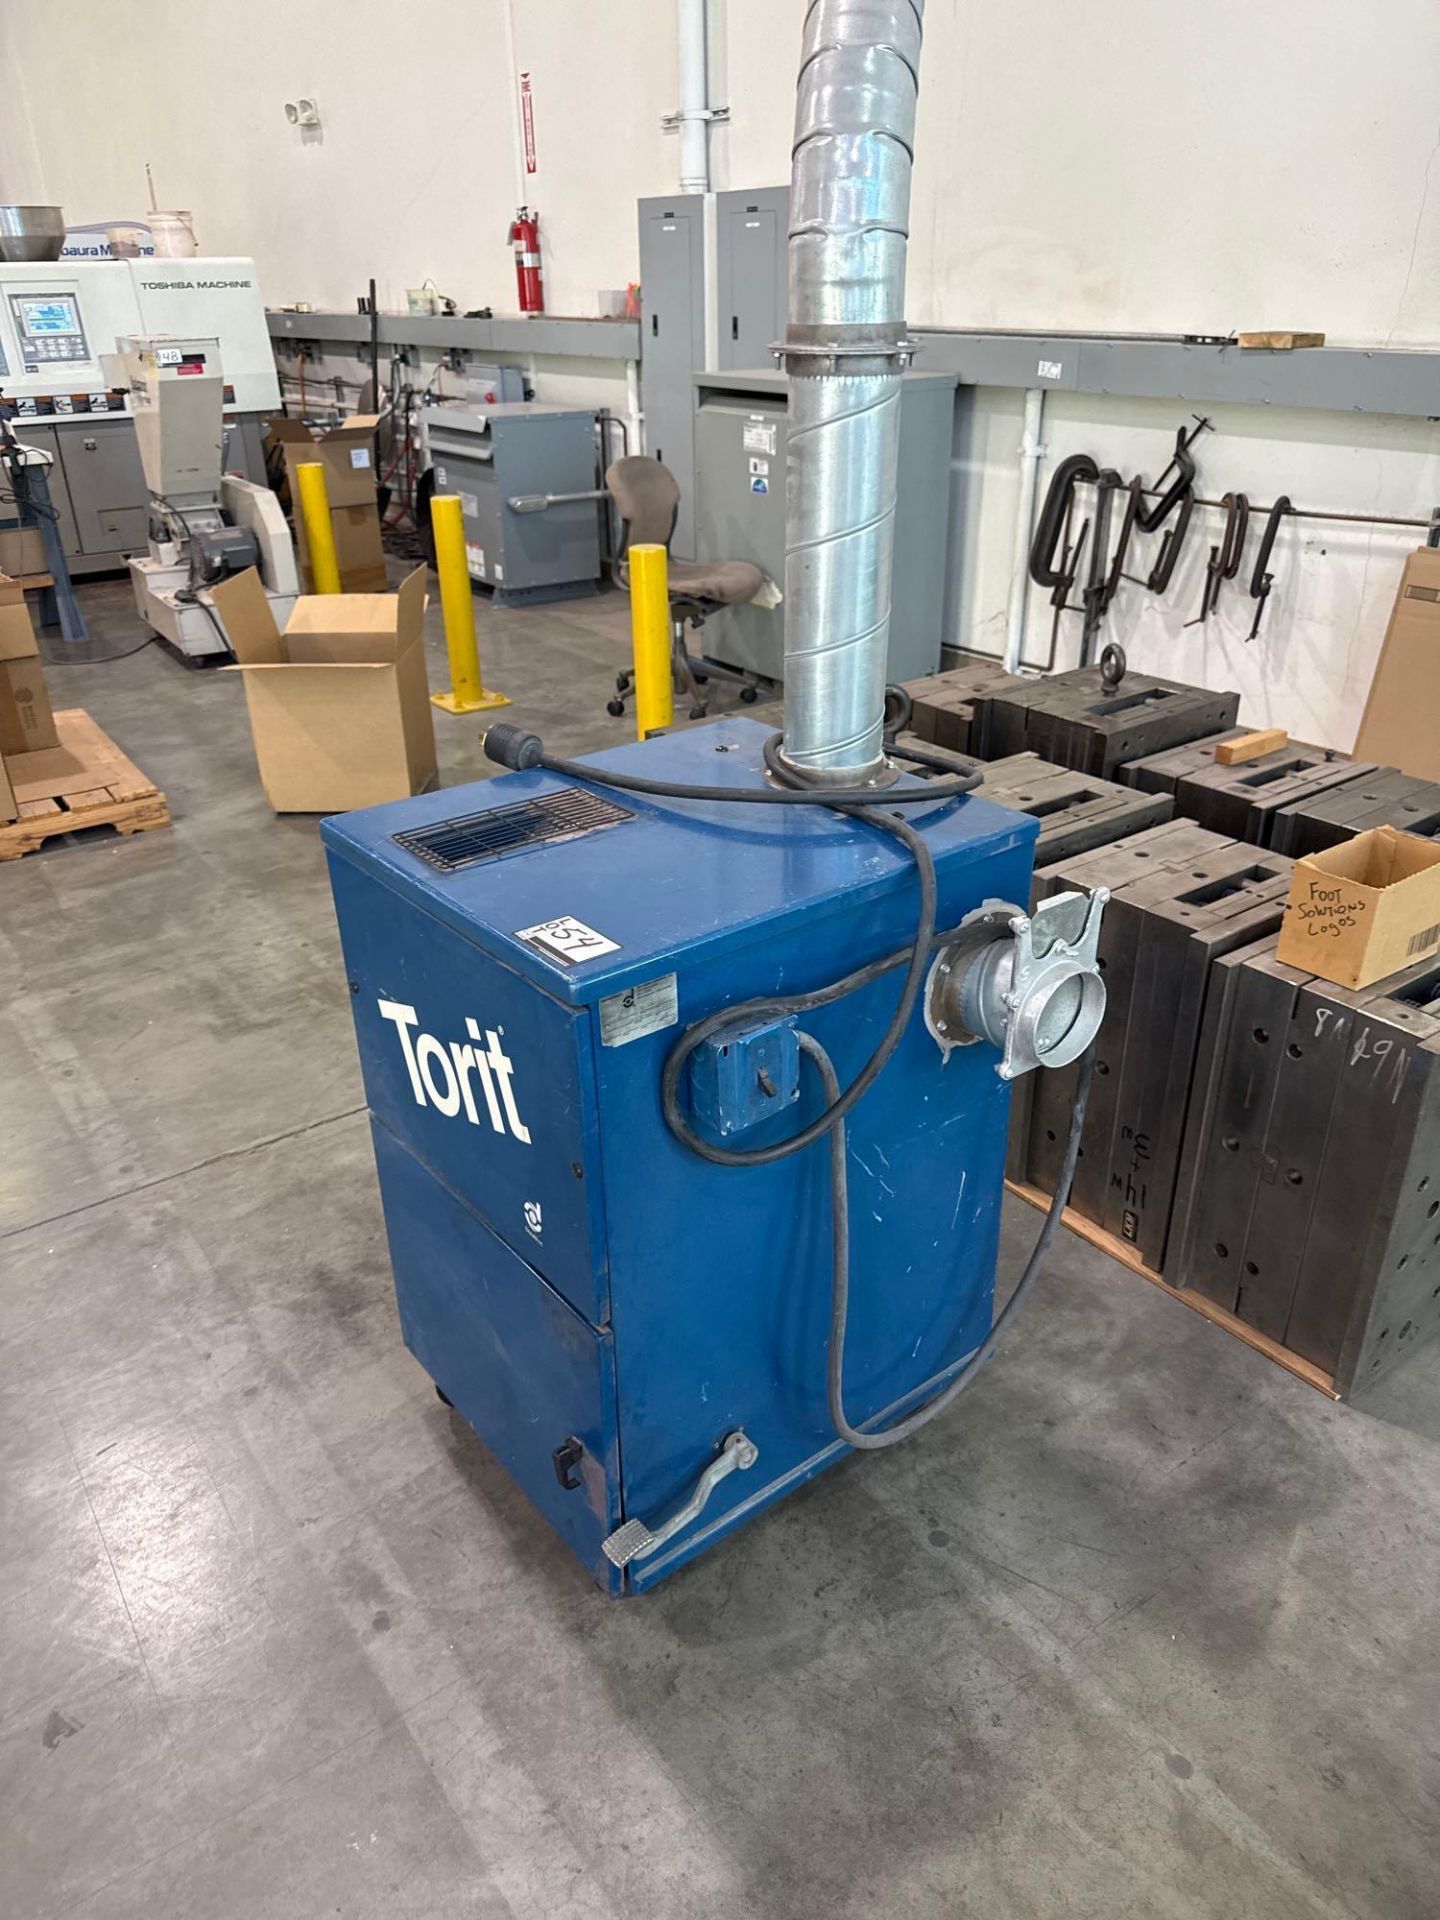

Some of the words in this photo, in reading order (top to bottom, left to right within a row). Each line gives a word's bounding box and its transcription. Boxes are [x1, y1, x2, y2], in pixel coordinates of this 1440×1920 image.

[140, 281, 195, 291] TOSHIBA
[197, 280, 252, 290] MACHINE
[376, 998, 532, 1145] Torit
